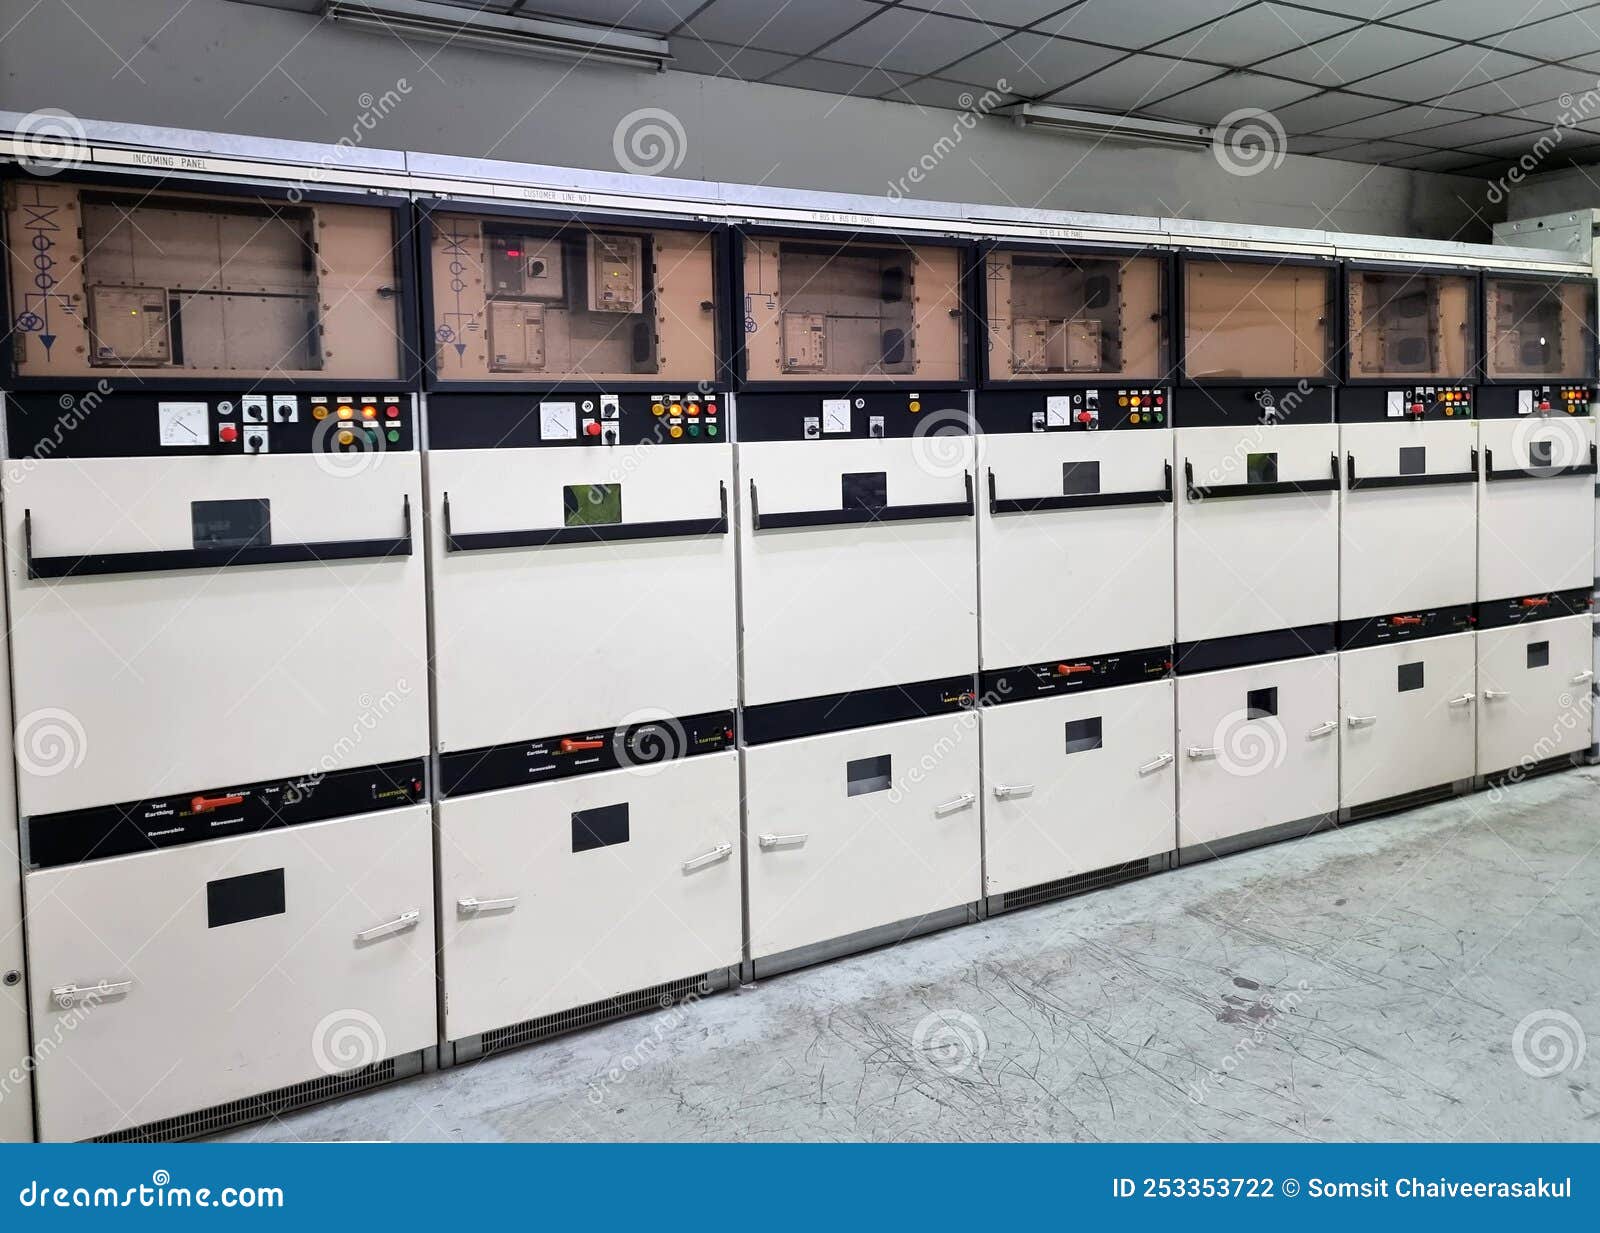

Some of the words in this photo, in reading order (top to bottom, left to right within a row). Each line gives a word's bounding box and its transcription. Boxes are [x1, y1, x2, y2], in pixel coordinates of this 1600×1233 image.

[132, 153, 174, 166] INCOMING
[181, 157, 207, 169] PANEL
[523, 189, 556, 200] CUSTOMER
[144, 809, 174, 818] Earthing
[210, 817, 244, 827] Movement
[147, 827, 185, 837] Removable
